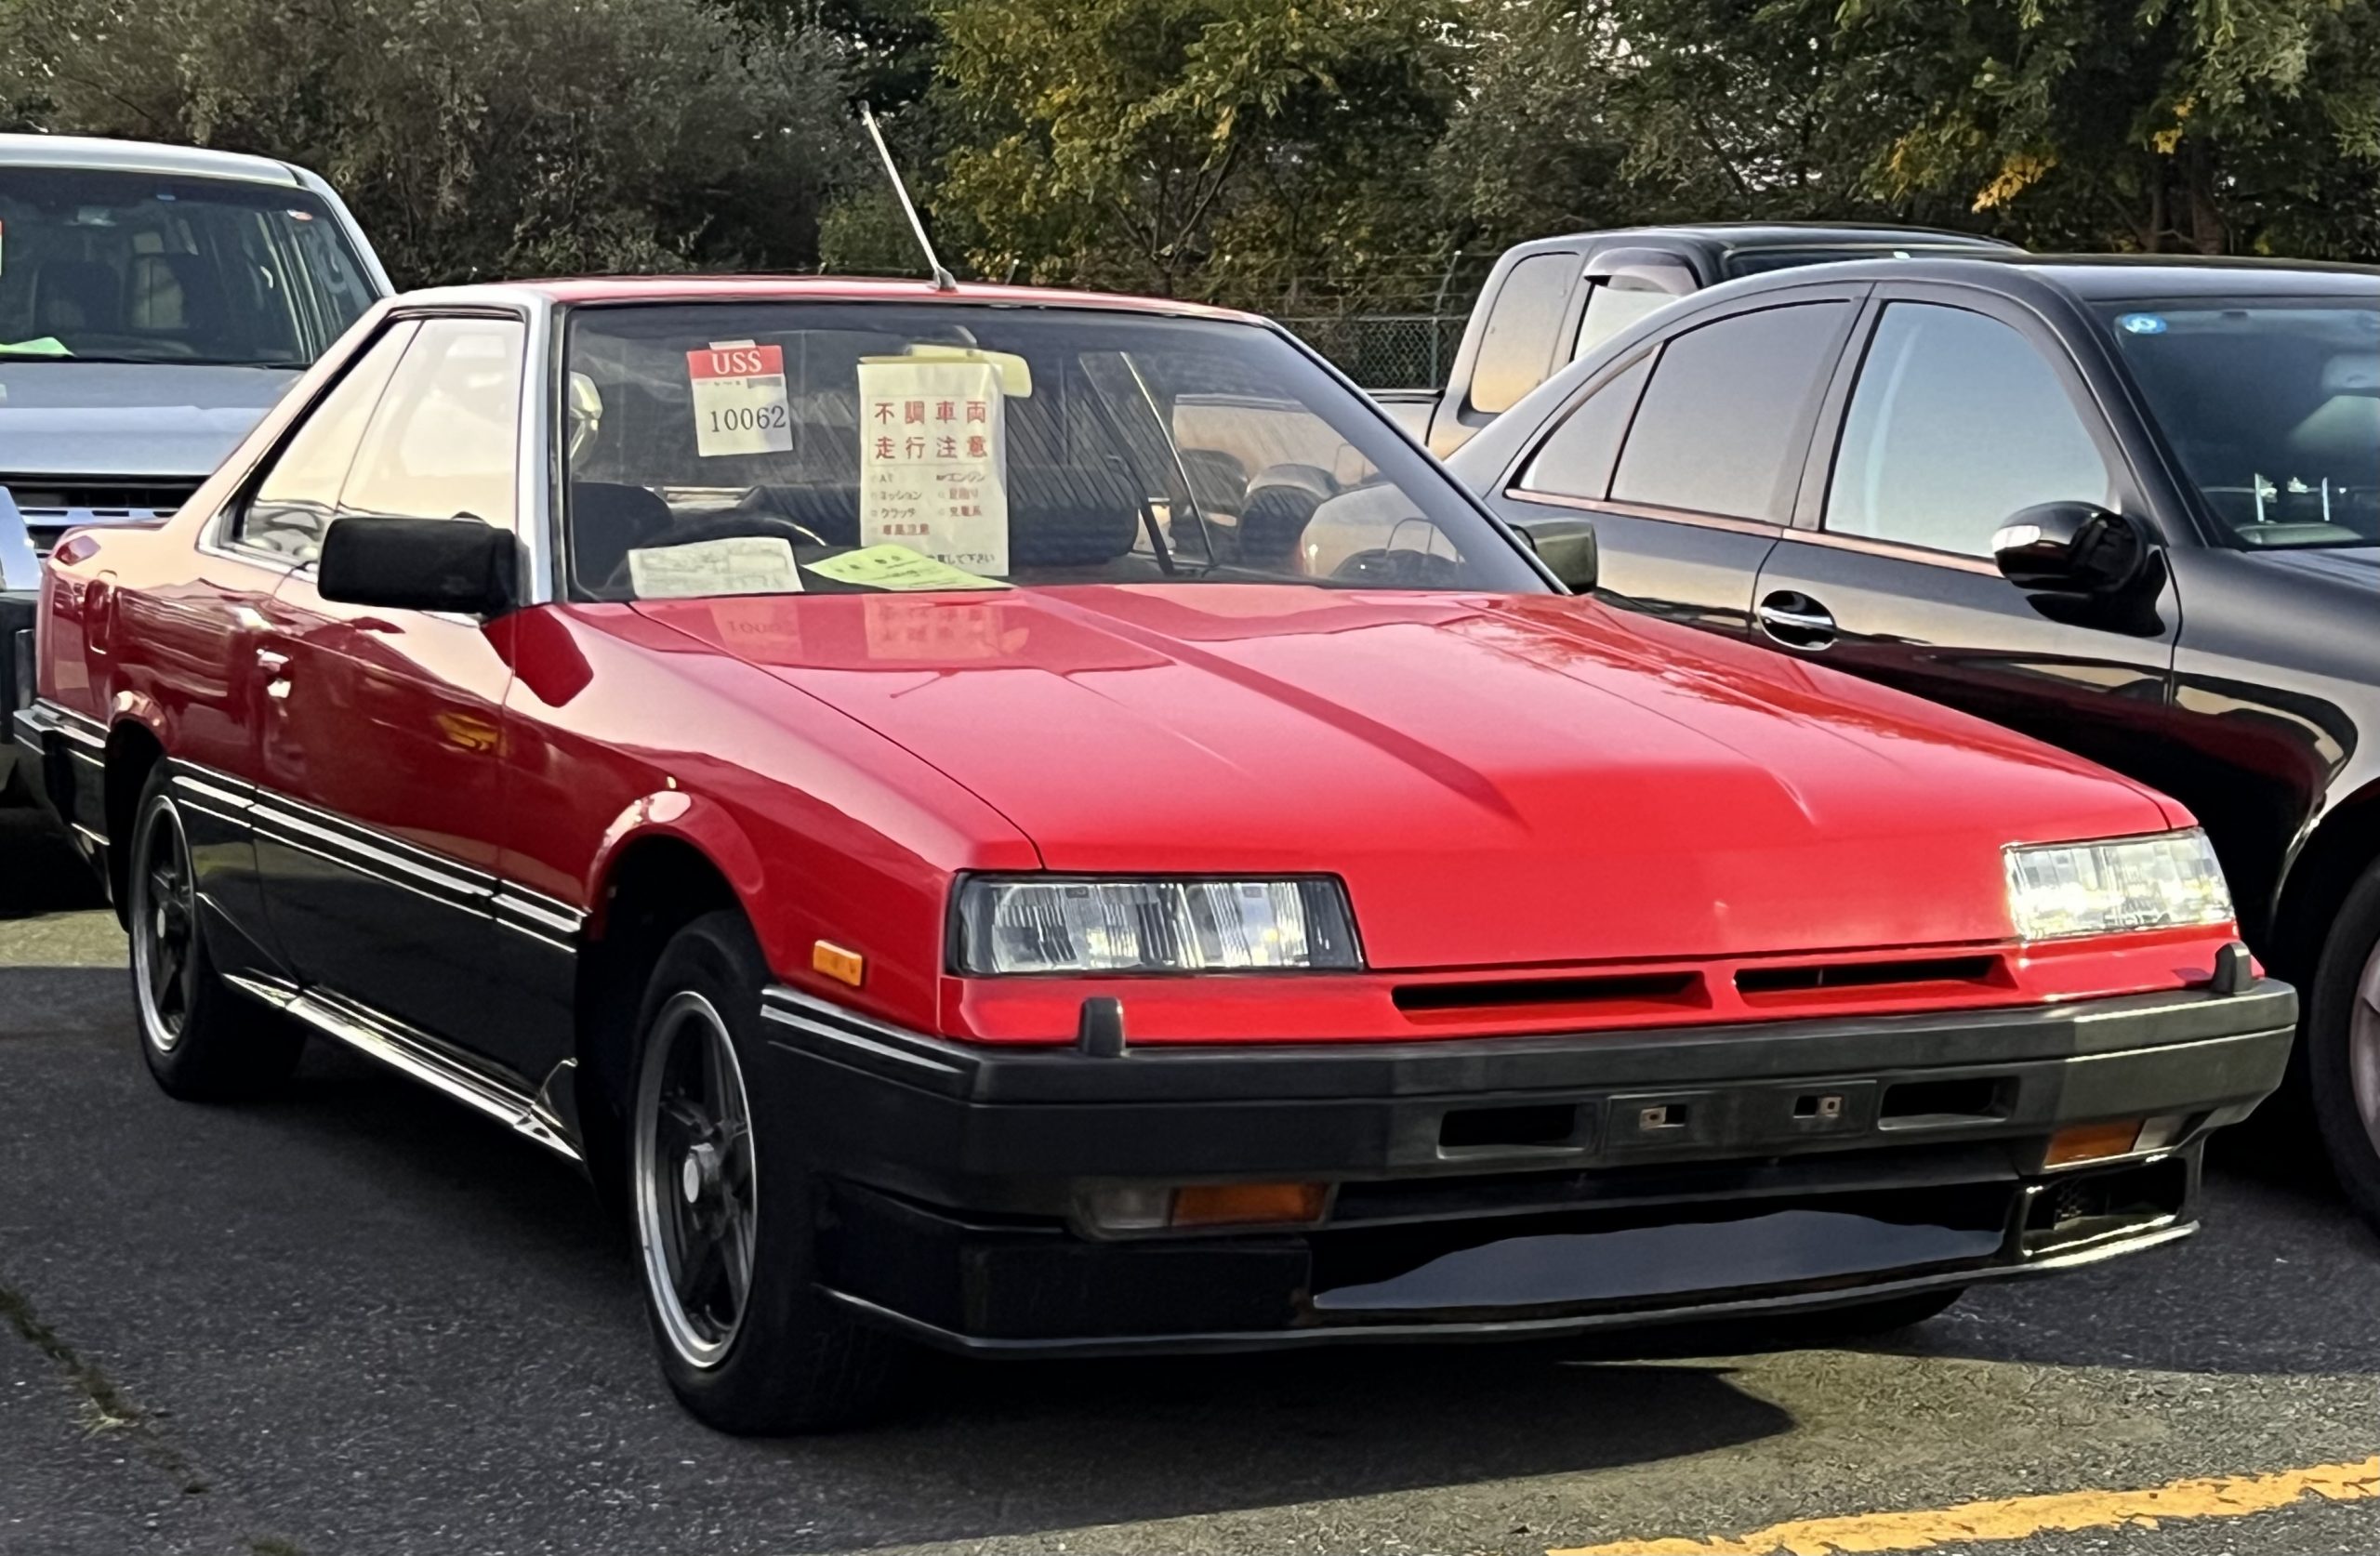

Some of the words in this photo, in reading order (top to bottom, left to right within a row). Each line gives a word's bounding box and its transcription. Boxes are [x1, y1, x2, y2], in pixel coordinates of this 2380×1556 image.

[712, 350, 762, 375] USS
[710, 405, 787, 433] 10062
[875, 400, 986, 425] 不調車両
[875, 435, 988, 460] 走行注意
[932, 552, 997, 565] して下さい
